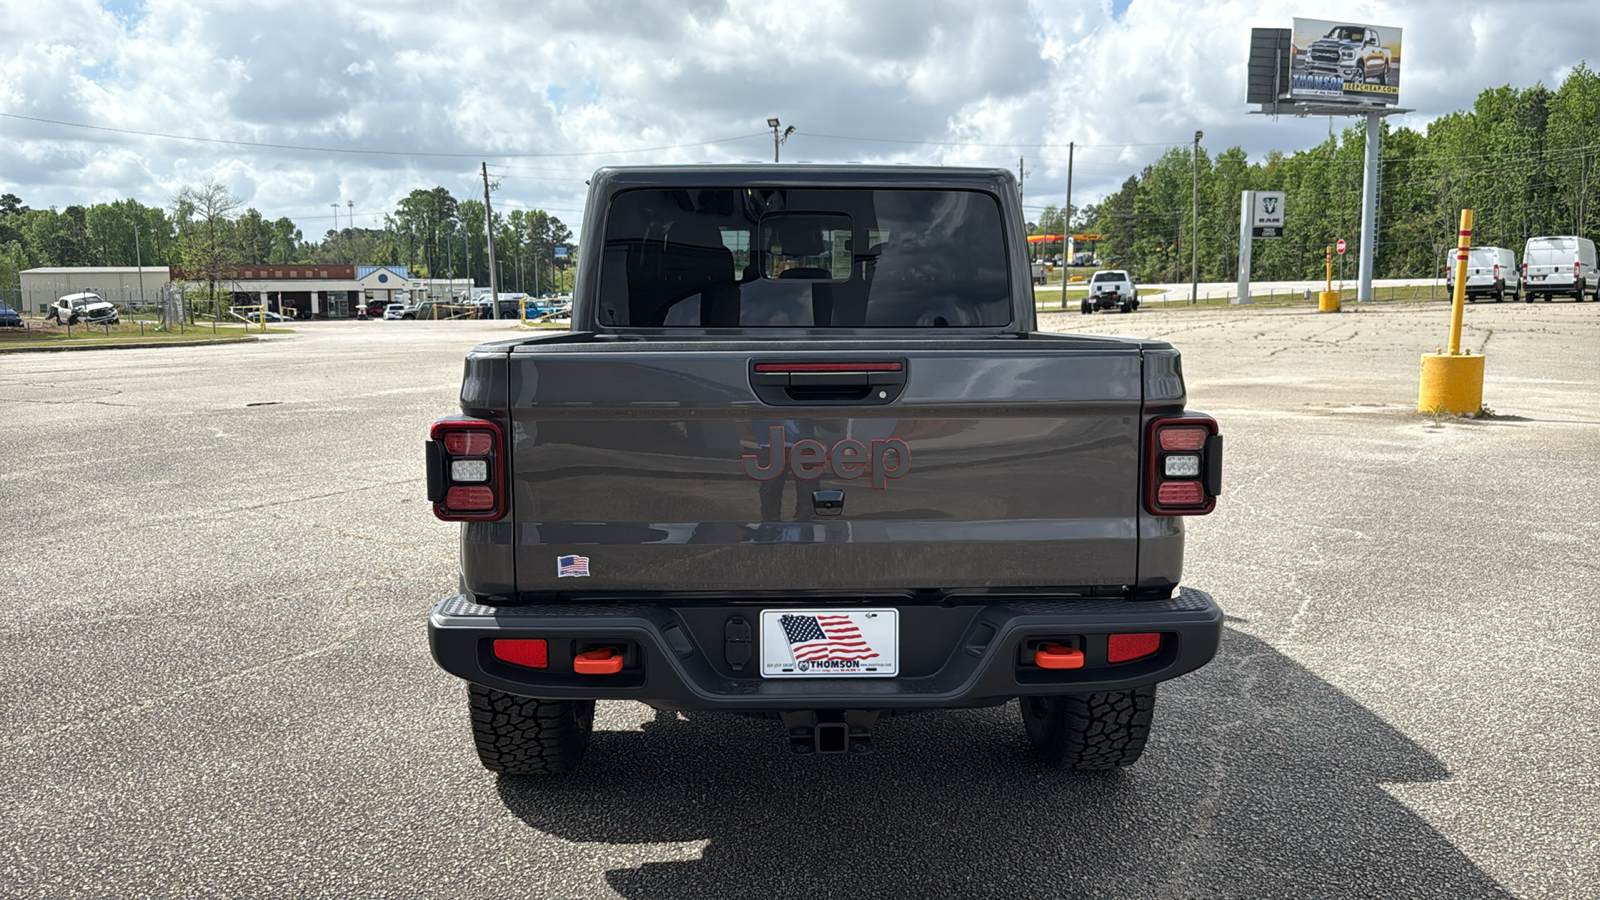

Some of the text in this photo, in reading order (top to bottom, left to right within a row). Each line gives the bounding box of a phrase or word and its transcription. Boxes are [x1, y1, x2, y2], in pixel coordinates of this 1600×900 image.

[1293, 75, 1344, 90] THOMSON
[1345, 83, 1397, 93] JEEPCHEAP.COM
[741, 425, 912, 491] Jeep
[810, 660, 860, 668] THOMSON
